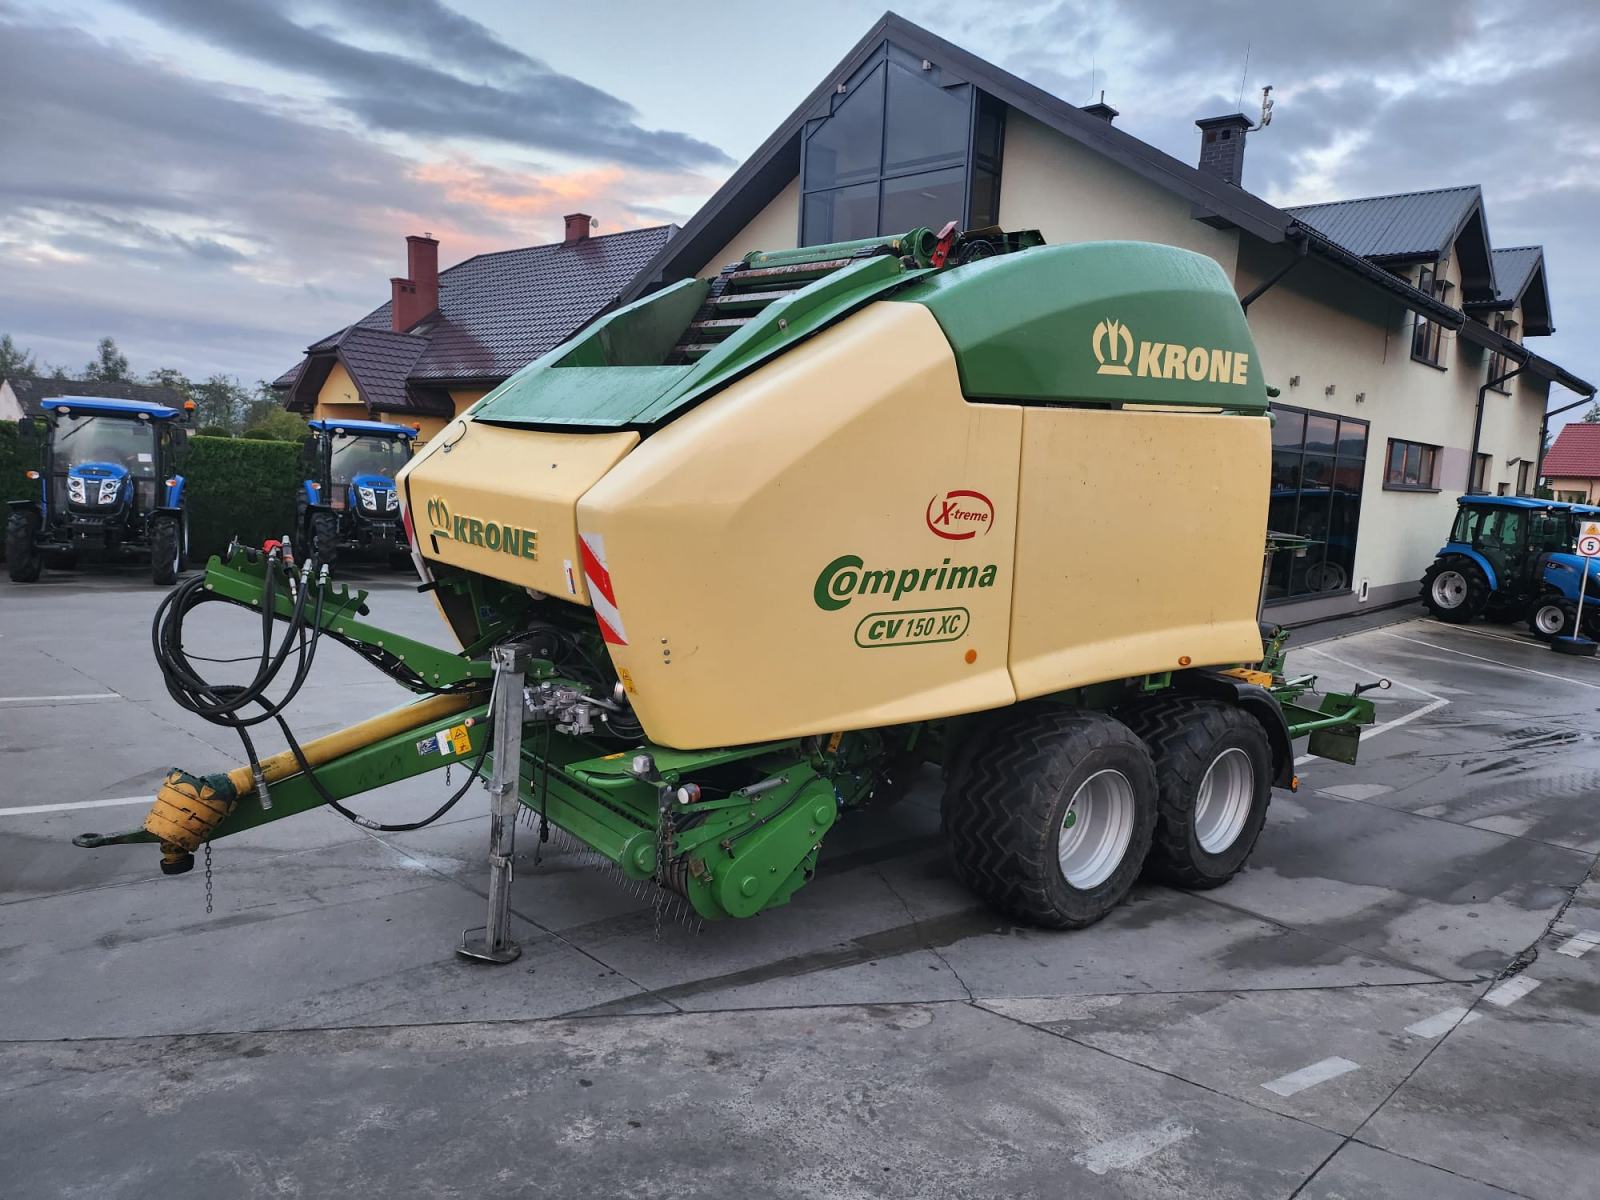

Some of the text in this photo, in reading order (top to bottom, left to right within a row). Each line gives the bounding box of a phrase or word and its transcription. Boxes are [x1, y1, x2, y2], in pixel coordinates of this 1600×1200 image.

[1137, 341, 1249, 385] KRONE
[933, 500, 988, 526] X-treme
[453, 514, 538, 561] KRONE
[1587, 541, 1595, 551] 5
[813, 554, 998, 612] Comprima
[868, 614, 961, 640] CV 150 XC
